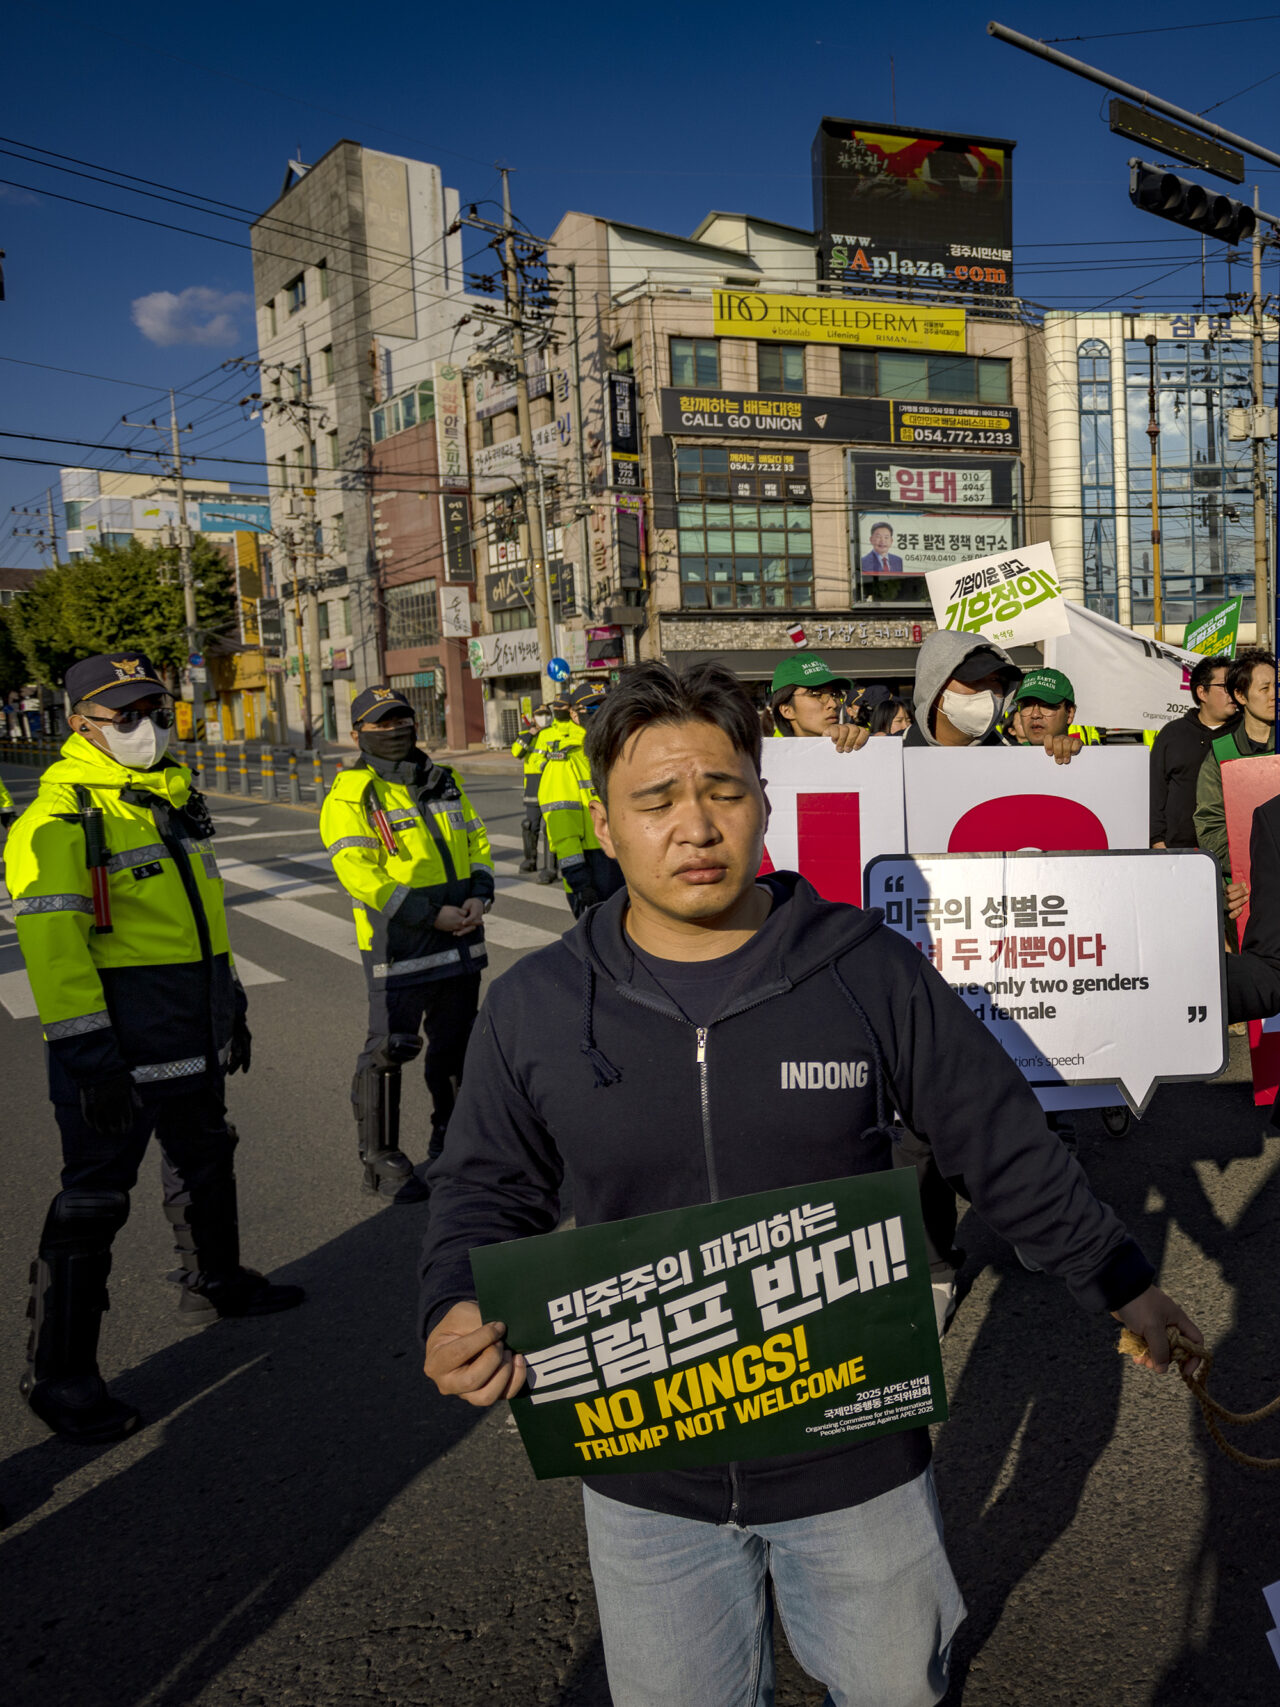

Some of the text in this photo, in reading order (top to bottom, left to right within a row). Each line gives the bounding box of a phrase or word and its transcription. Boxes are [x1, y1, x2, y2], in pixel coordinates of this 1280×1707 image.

[780, 305, 918, 333] INCELLDERM
[827, 330, 860, 342] Lifening
[876, 334, 908, 344] RIMAN
[680, 396, 802, 417] 함께하는 배달대행
[682, 412, 802, 431] CALL GO UNION
[914, 429, 1013, 445] 054.772.1233
[896, 469, 957, 503] 임대
[962, 473, 979, 481] 010
[962, 483, 985, 491] 4945
[962, 494, 985, 502] 5637
[897, 534, 1008, 551] 경주 발전 정책 연구소
[950, 558, 1031, 600] 기업이윤 말고
[945, 569, 1063, 631] 기후정의!
[815, 623, 909, 645] 하삼동커피
[992, 629, 1014, 641] 녹색당
[1166, 702, 1190, 713] 2025
[885, 894, 1069, 931] 미국의 성별은
[952, 933, 1107, 971] 두 개뿐이다
[984, 977, 1025, 998] only
[1030, 978, 1068, 994] two
[1072, 973, 1150, 996] genders
[990, 1002, 1057, 1021] female
[1045, 1053, 1085, 1069] speech
[781, 1059, 869, 1090] INDONG
[547, 1202, 838, 1335] 민주주의 파괴하는
[525, 1215, 909, 1405] 트럼프 반대!
[574, 1325, 810, 1437] NO KINGS!
[856, 1375, 931, 1402] 2025 APEC 반대
[574, 1356, 866, 1461] TRUMP NOT WELCOME
[823, 1386, 932, 1418] 국제민중행동 조직위원회
[805, 1399, 933, 1435] Organizing Committee for the International
[819, 1405, 934, 1438] People's Response Against APEC 2025
